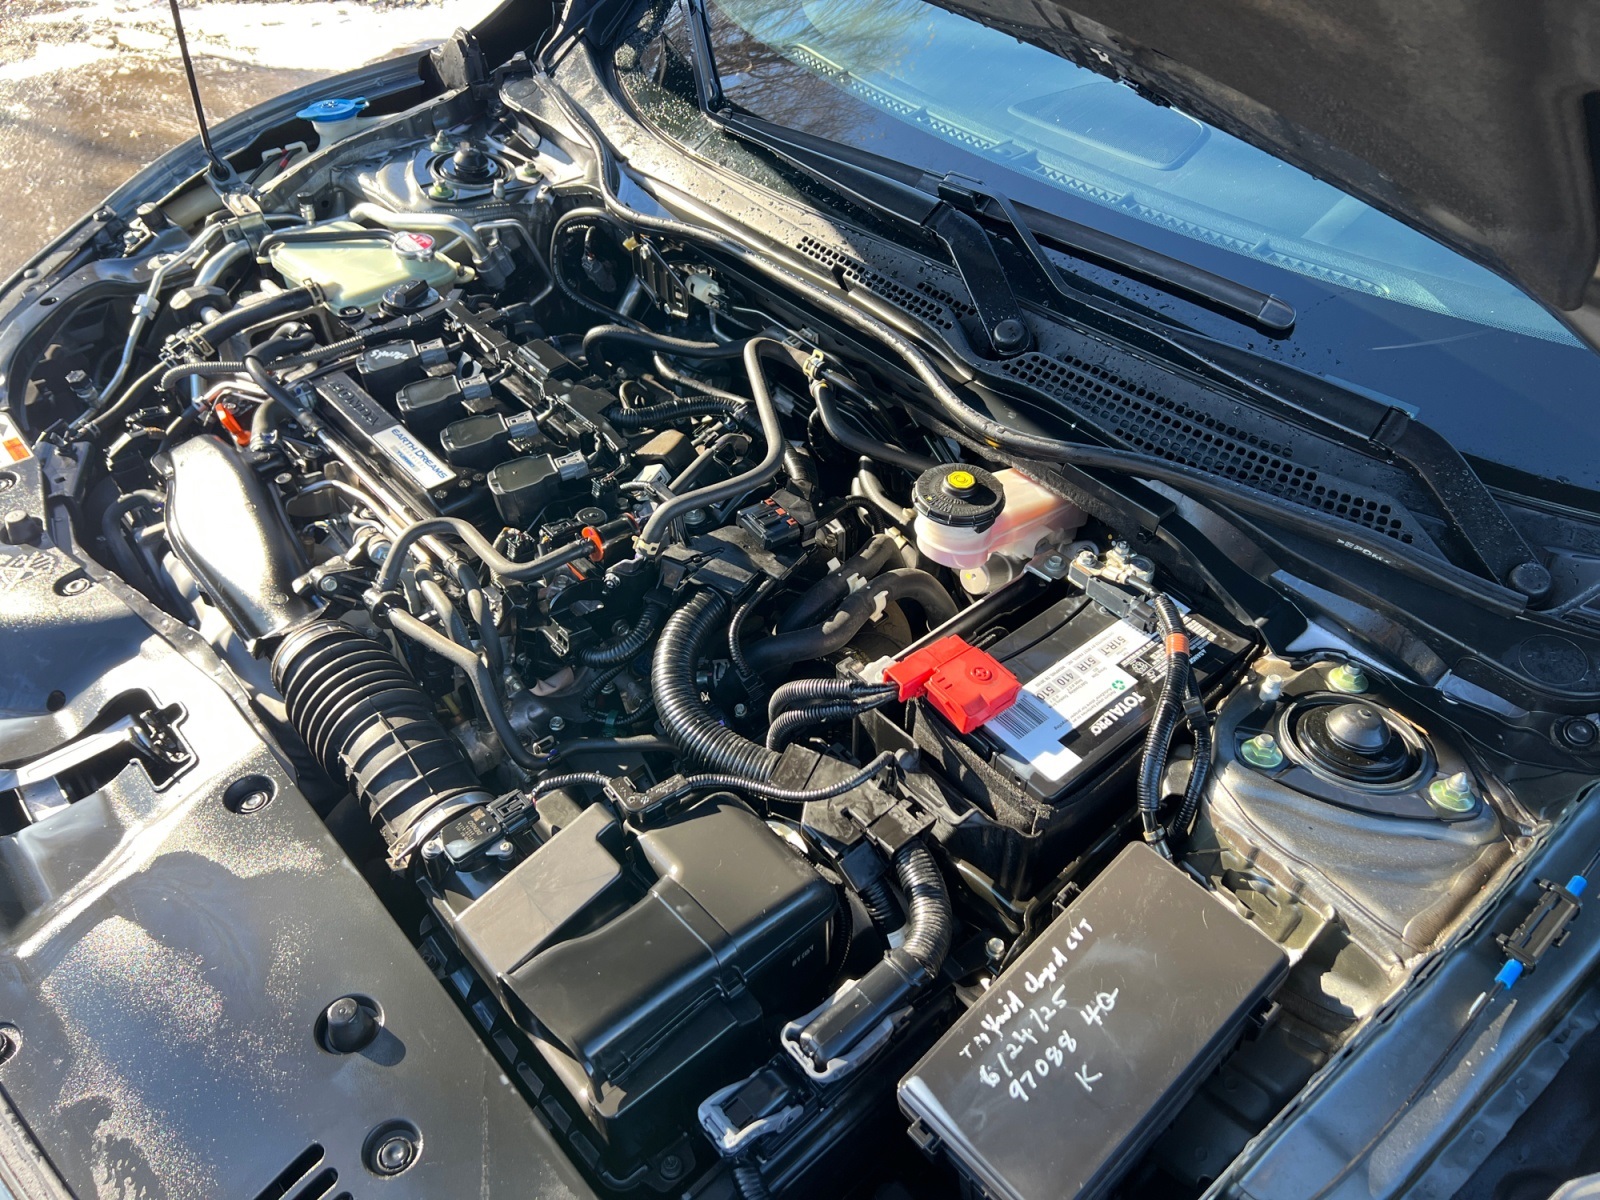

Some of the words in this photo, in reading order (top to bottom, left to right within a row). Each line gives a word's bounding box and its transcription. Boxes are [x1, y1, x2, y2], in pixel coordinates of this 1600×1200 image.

[326, 379, 379, 427] HONDA
[390, 427, 417, 450] EARTH
[414, 449, 447, 479] DREAMS
[395, 450, 414, 467] TURBO
[1099, 635, 1125, 655] 51R-T
[1076, 656, 1096, 672] 51R
[1056, 671, 1073, 686] 410
[1036, 685, 1054, 701] 510
[467, 820, 482, 835] DENSO
[1009, 1030, 1077, 1102] 97088
[1075, 1062, 1103, 1092] K
